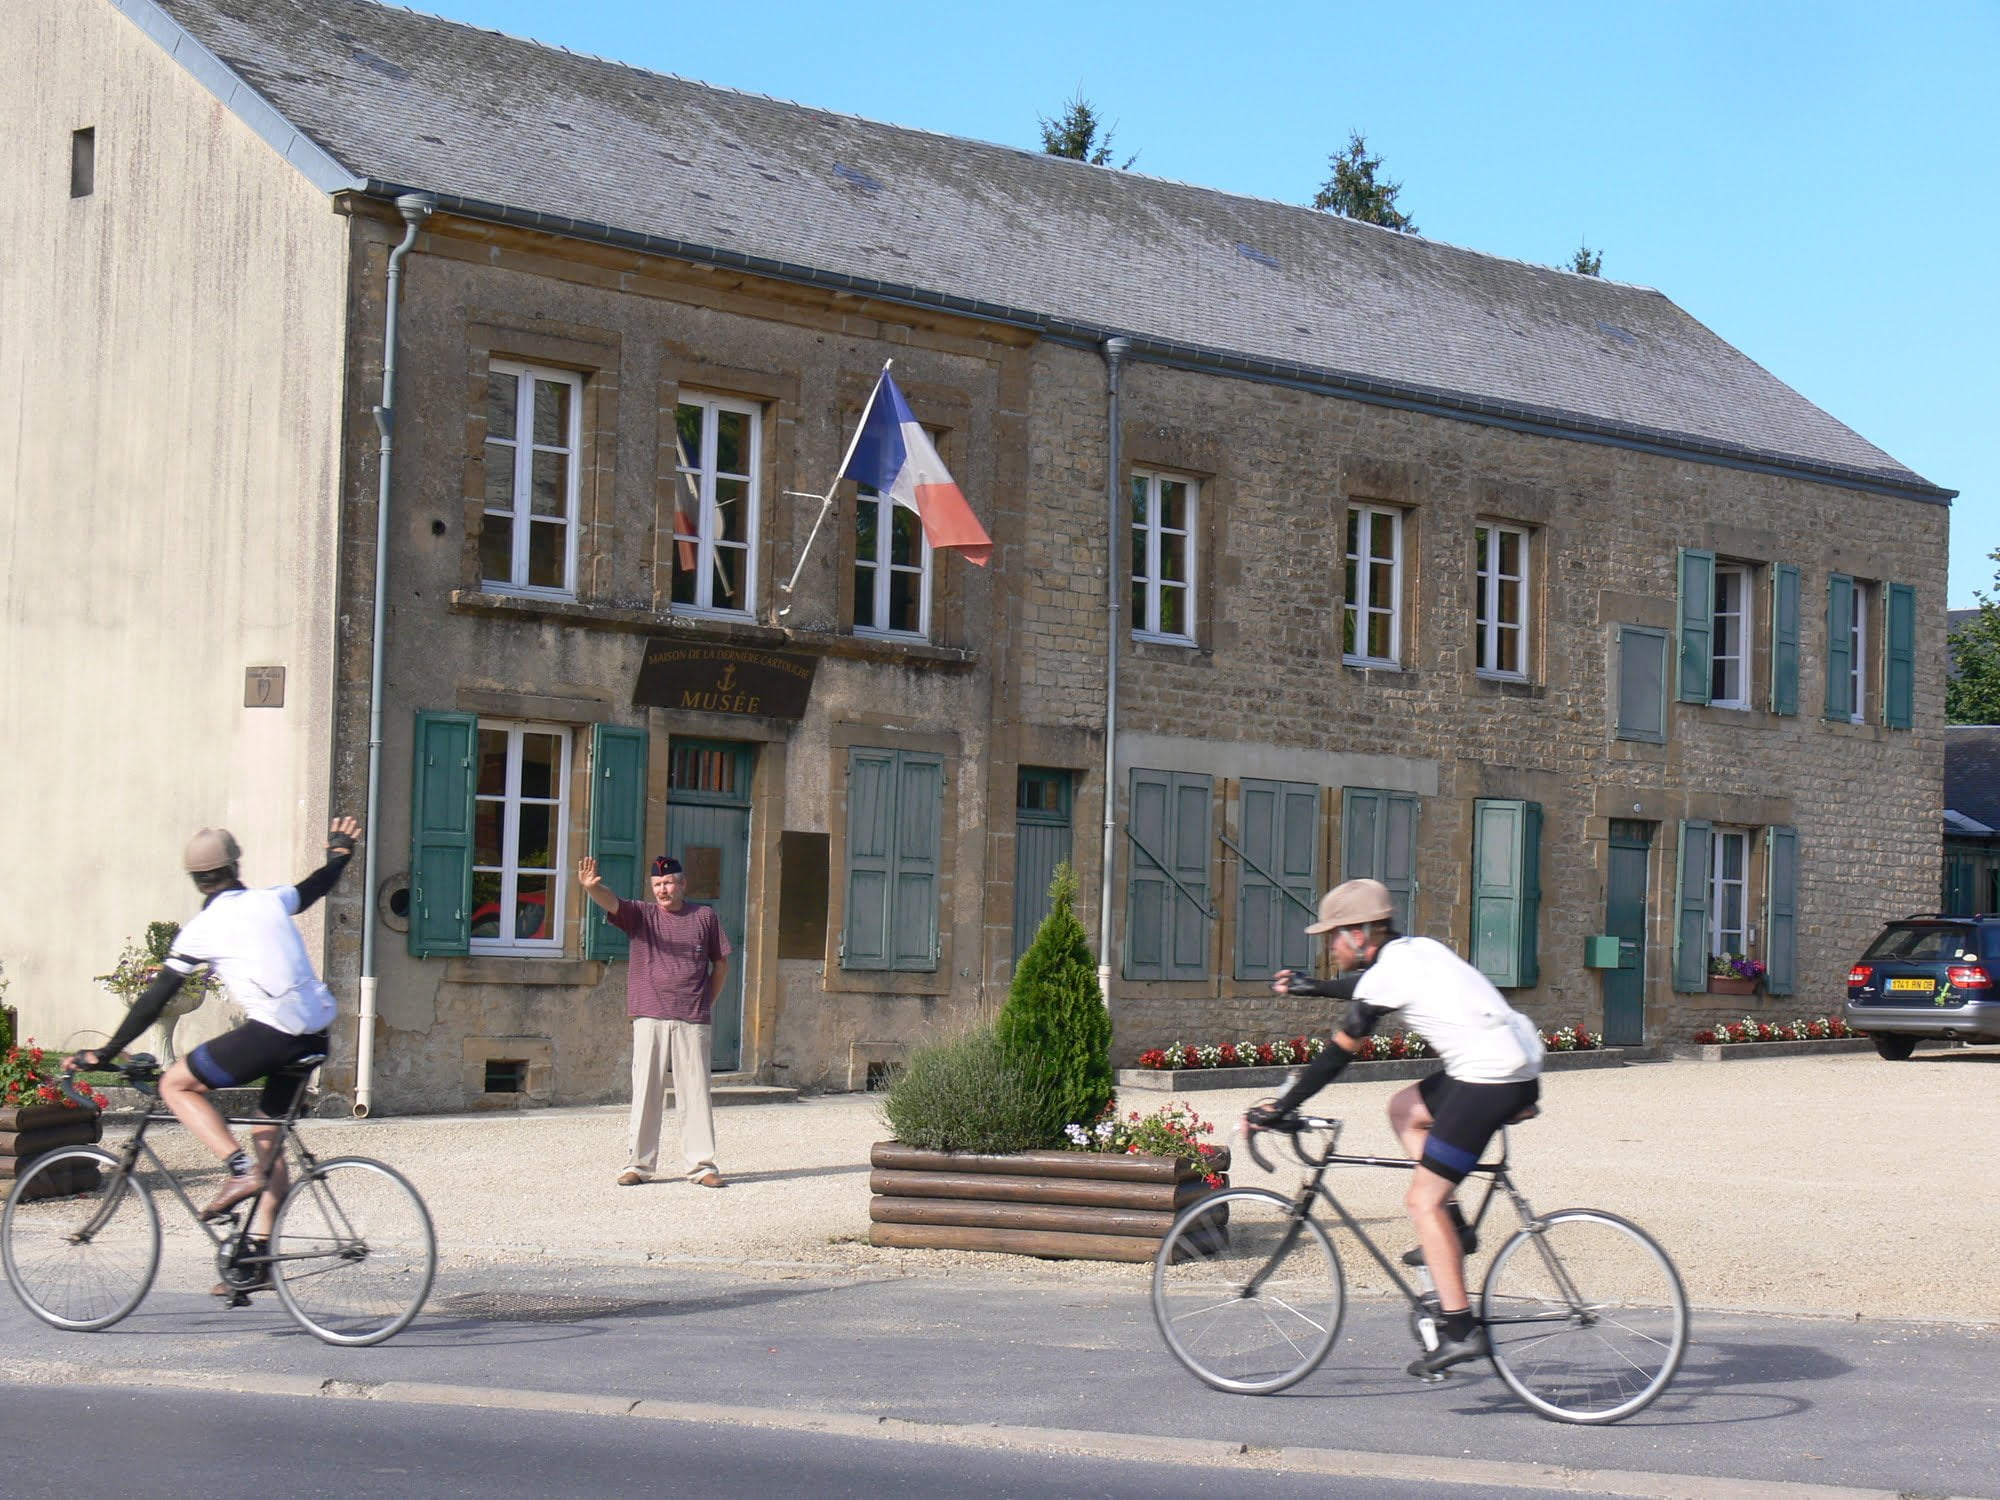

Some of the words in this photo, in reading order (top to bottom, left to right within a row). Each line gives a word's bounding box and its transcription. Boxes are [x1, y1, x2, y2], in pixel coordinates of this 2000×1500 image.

[648, 648, 687, 664] MAISON
[688, 647, 701, 659] DE
[703, 647, 715, 659] LA
[760, 655, 809, 680] CARTOUCHE
[680, 690, 760, 713] MUSÉE
